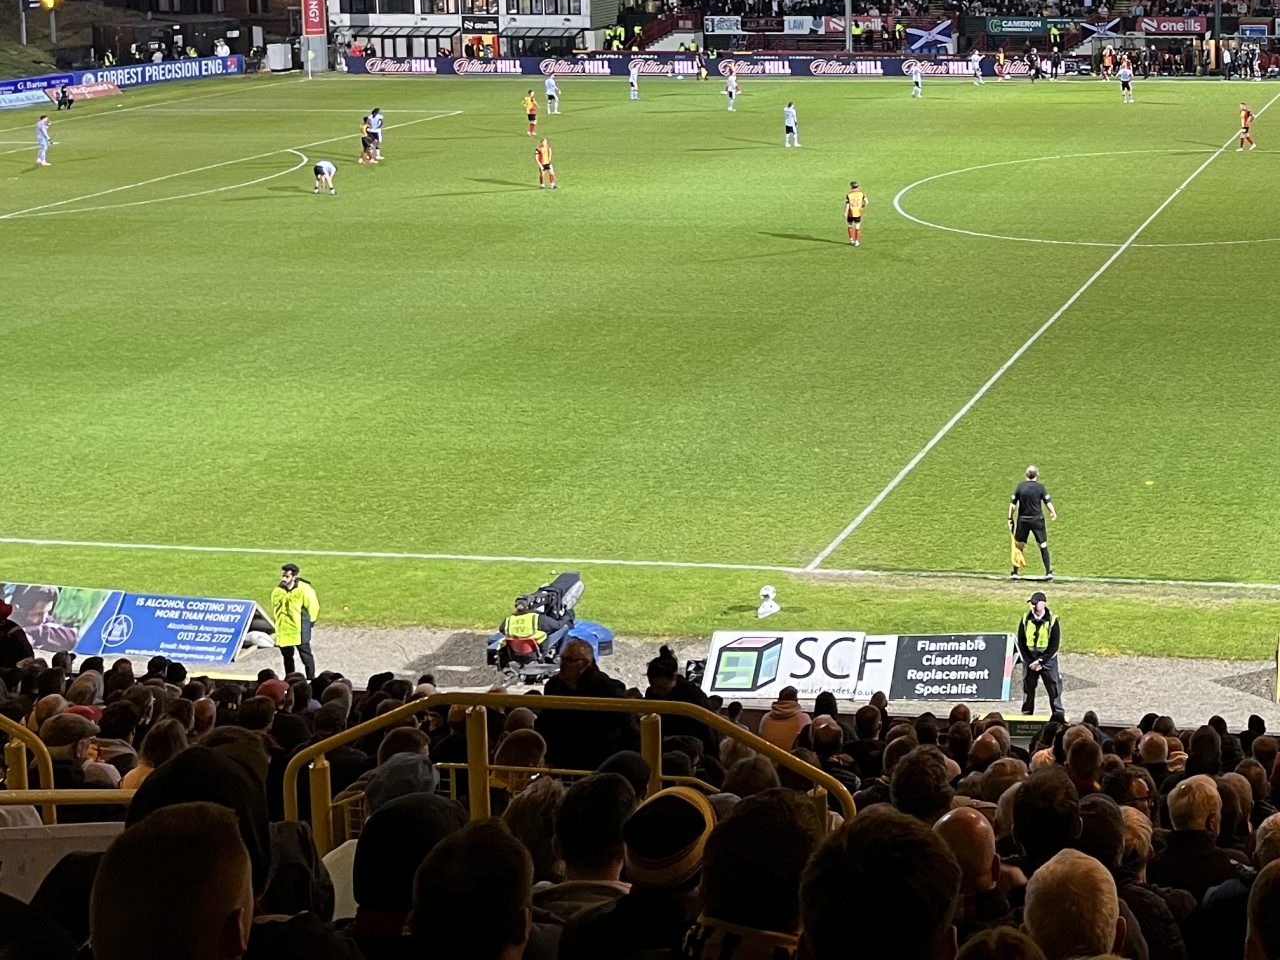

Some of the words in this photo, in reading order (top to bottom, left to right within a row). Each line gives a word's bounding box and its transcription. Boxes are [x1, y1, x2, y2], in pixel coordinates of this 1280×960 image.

[788, 19, 804, 30] LAW
[365, 58, 411, 73] William
[411, 60, 437, 73] HILL
[453, 58, 496, 73] William
[496, 60, 522, 73] HILL
[539, 58, 584, 74] William
[585, 60, 610, 74] HILL
[765, 61, 791, 74] HILL
[810, 59, 856, 74] William
[857, 61, 883, 74] HILL
[97, 67, 143, 86] FORREST
[145, 61, 199, 82] PRECISION
[202, 59, 226, 75] ENG.
[27, 80, 48, 89] Barton
[136, 598, 145, 606] IS
[145, 598, 185, 609] ALCOHOL
[187, 601, 224, 612] COSTING
[226, 604, 245, 613] YOU
[155, 609, 180, 619] MORE
[181, 611, 204, 621] THAN
[206, 613, 241, 623] MONEY?
[167, 622, 198, 631] Alcoholics
[200, 625, 235, 633] Anonymous
[177, 632, 195, 641] 0131
[195, 633, 212, 642] 225
[213, 635, 232, 643] 2727
[917, 640, 986, 651] Flammable
[790, 636, 886, 681] SCF
[922, 654, 978, 667] Cladding
[907, 669, 989, 682] Replacement
[914, 683, 978, 696] Specialist
